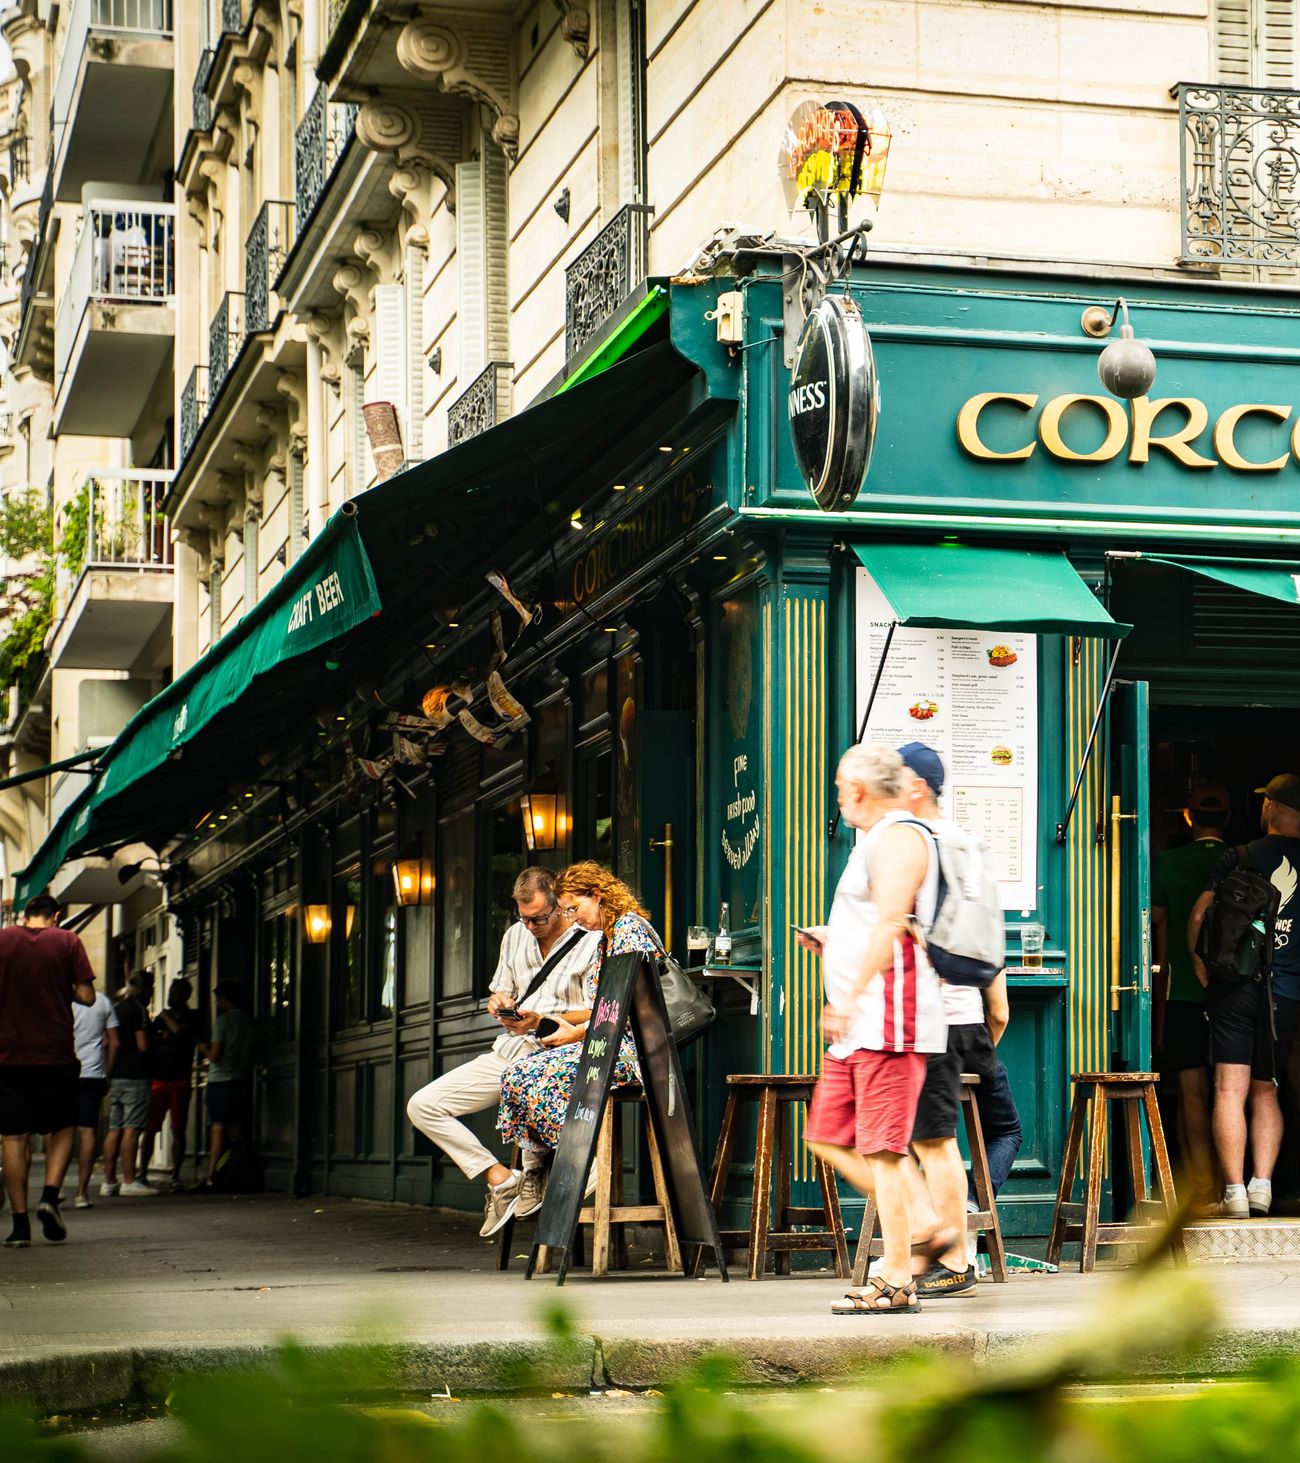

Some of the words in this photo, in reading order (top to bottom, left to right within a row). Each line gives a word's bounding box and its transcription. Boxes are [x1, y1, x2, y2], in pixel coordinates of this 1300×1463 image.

[287, 590, 313, 634] CRAFT
[315, 571, 345, 616] BEER
[924, 1274, 966, 1289] bugatti
